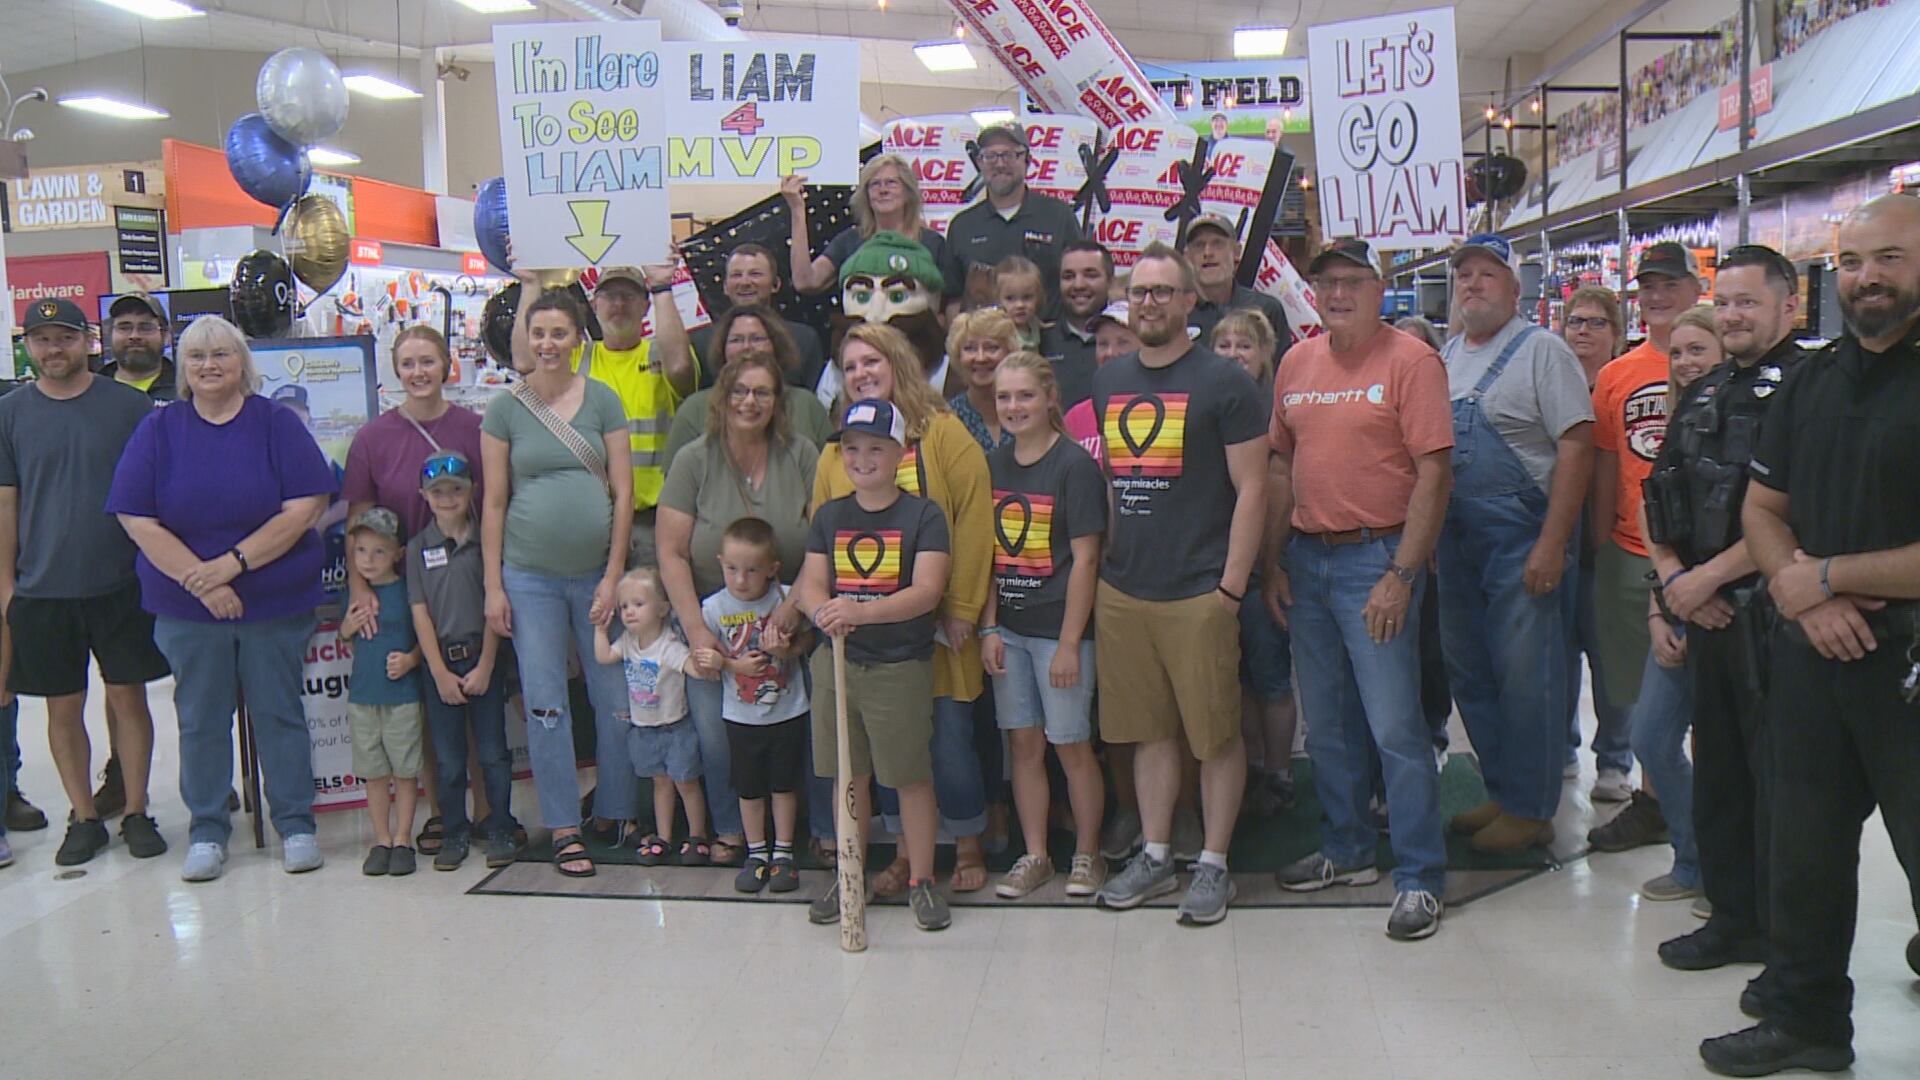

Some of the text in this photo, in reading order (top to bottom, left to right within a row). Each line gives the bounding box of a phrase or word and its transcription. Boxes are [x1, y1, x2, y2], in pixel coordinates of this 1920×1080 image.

[512, 35, 659, 94] I'm Here
[690, 53, 815, 101] LIAM
[1336, 21, 1434, 98] LET'S
[1096, 76, 1152, 123] ACE
[1201, 75, 1301, 109] FIELD
[513, 99, 639, 149] To See
[721, 102, 765, 135] 4
[884, 123, 944, 147] ACE
[1338, 100, 1418, 171] GO
[525, 146, 663, 196] LIAM
[668, 136, 822, 177] MVP
[16, 172, 104, 200] LAWN &
[131, 174, 139, 192] 1
[1323, 159, 1464, 238] LIAM
[18, 198, 106, 226] GARDEN
[1283, 388, 1366, 407] carhartt
[1131, 479, 1171, 490] miracles
[1007, 575, 1042, 588] miracles
